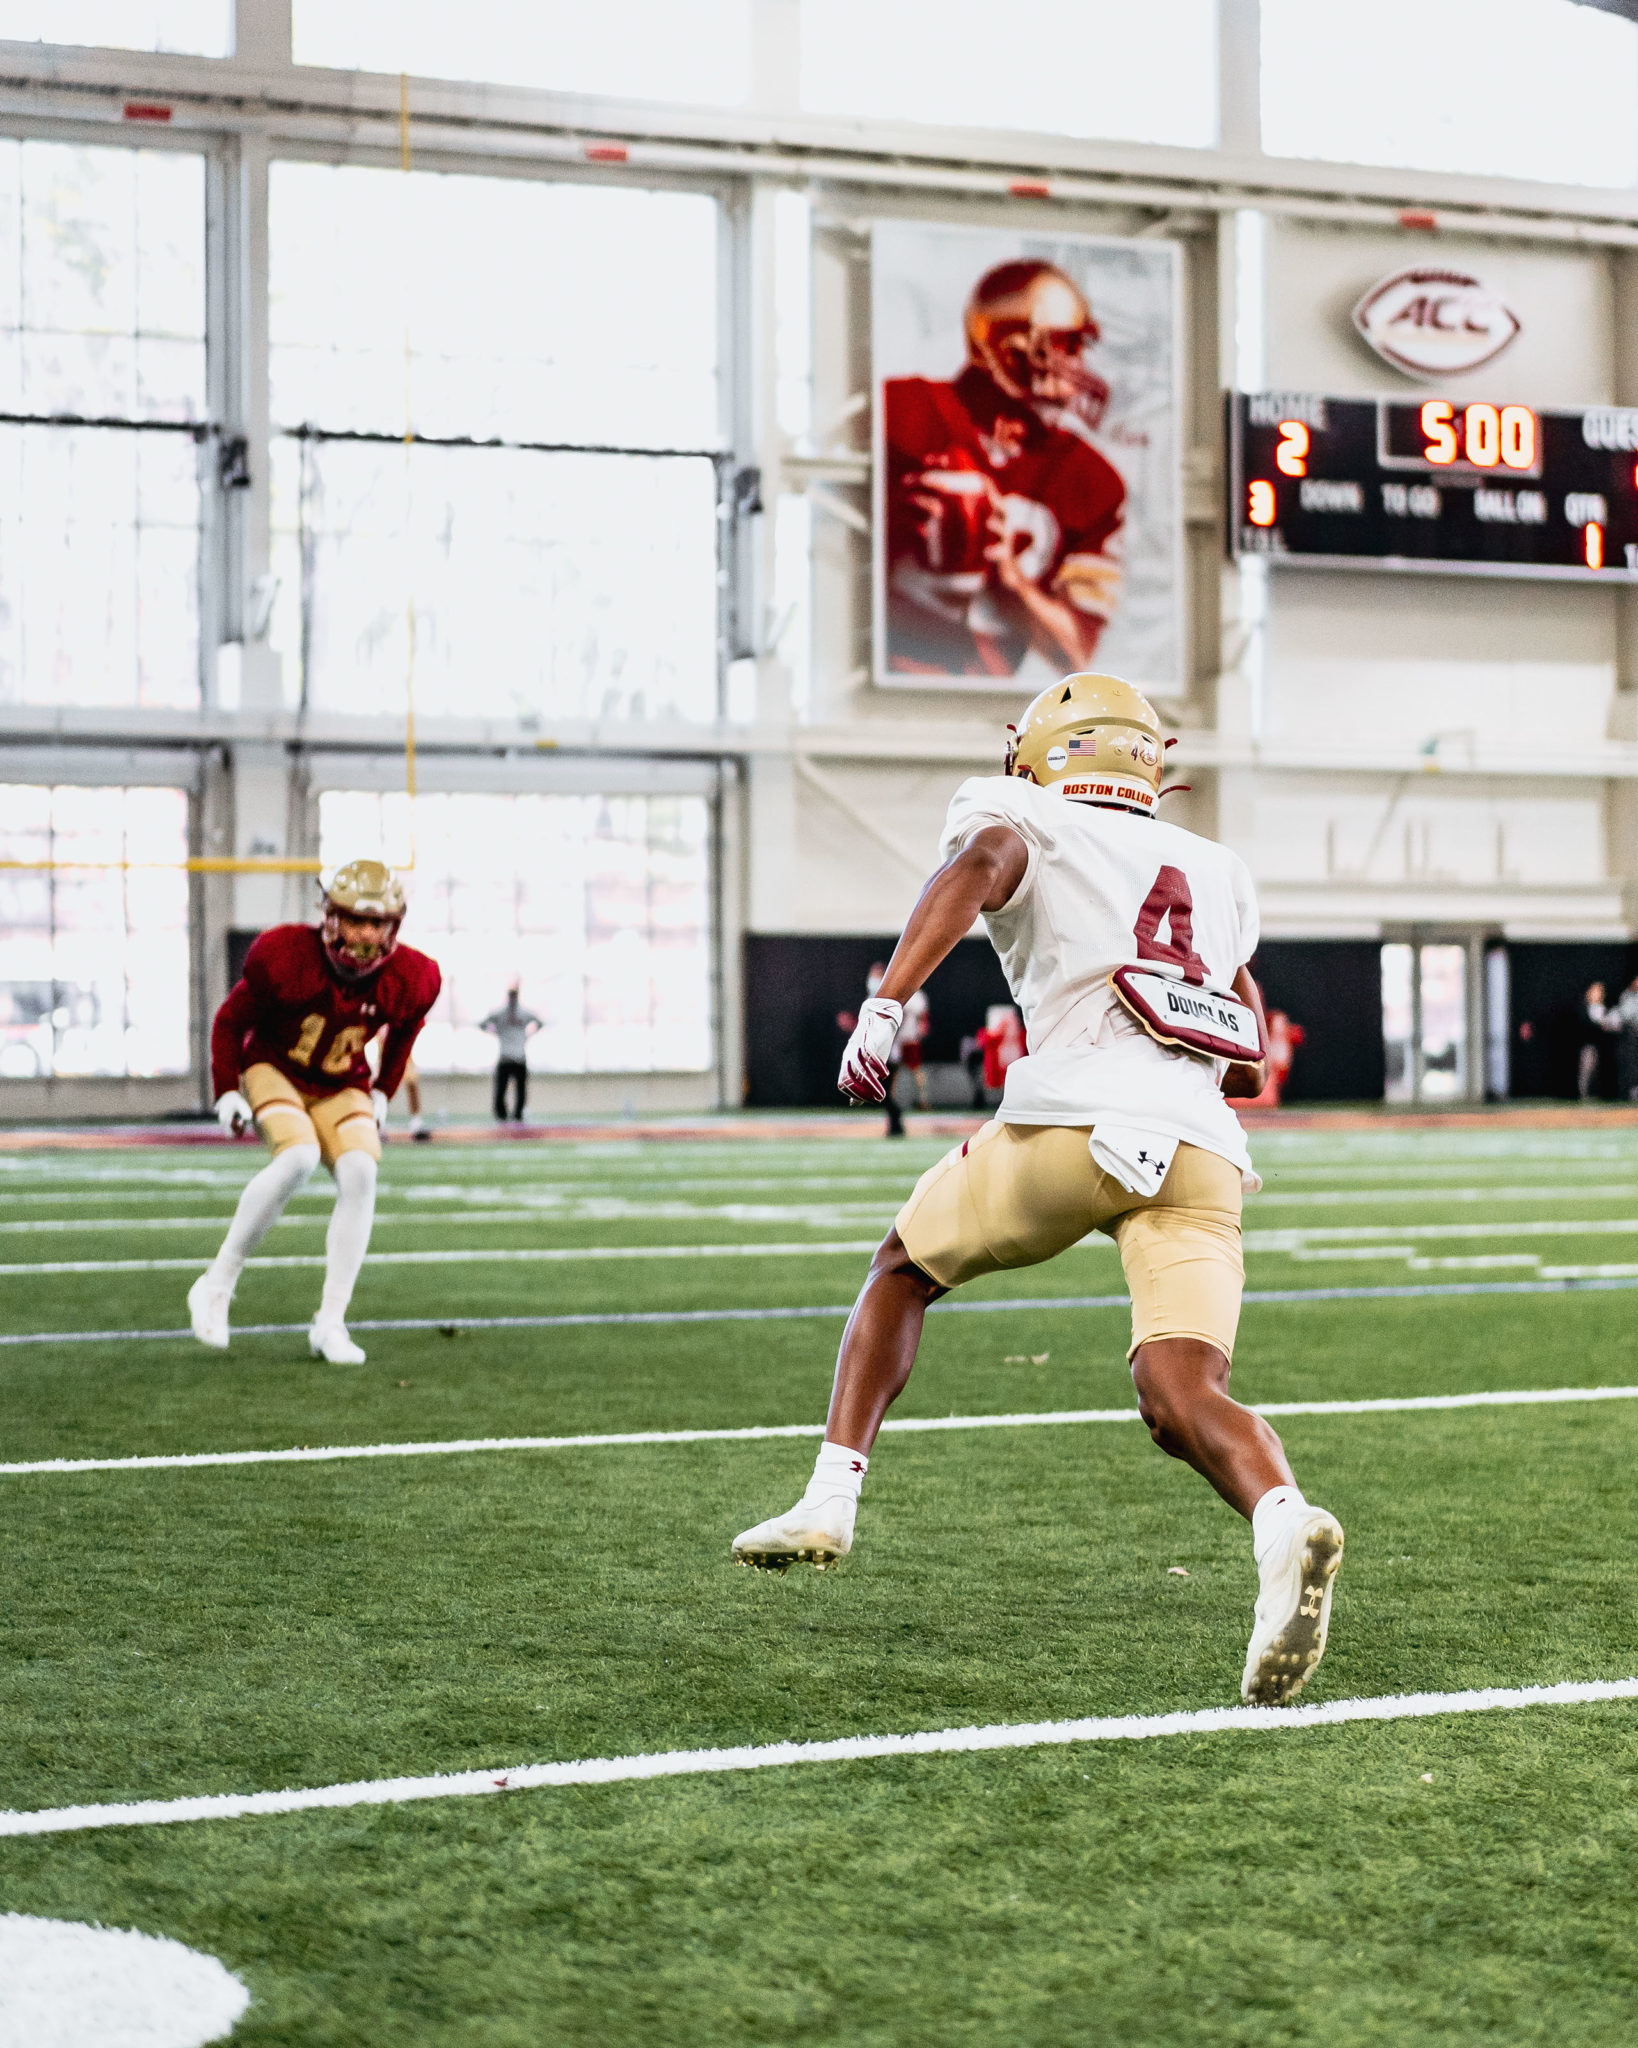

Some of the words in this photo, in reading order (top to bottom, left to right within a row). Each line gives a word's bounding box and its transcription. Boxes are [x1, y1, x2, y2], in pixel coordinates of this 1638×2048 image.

[1277, 420, 1310, 477] 2
[1248, 479, 1276, 527] 3
[1585, 520, 1604, 571] 1
[1063, 783, 1114, 796] BOSTON
[1133, 865, 1211, 986] 4
[1167, 991, 1240, 1033] DOUGLAS
